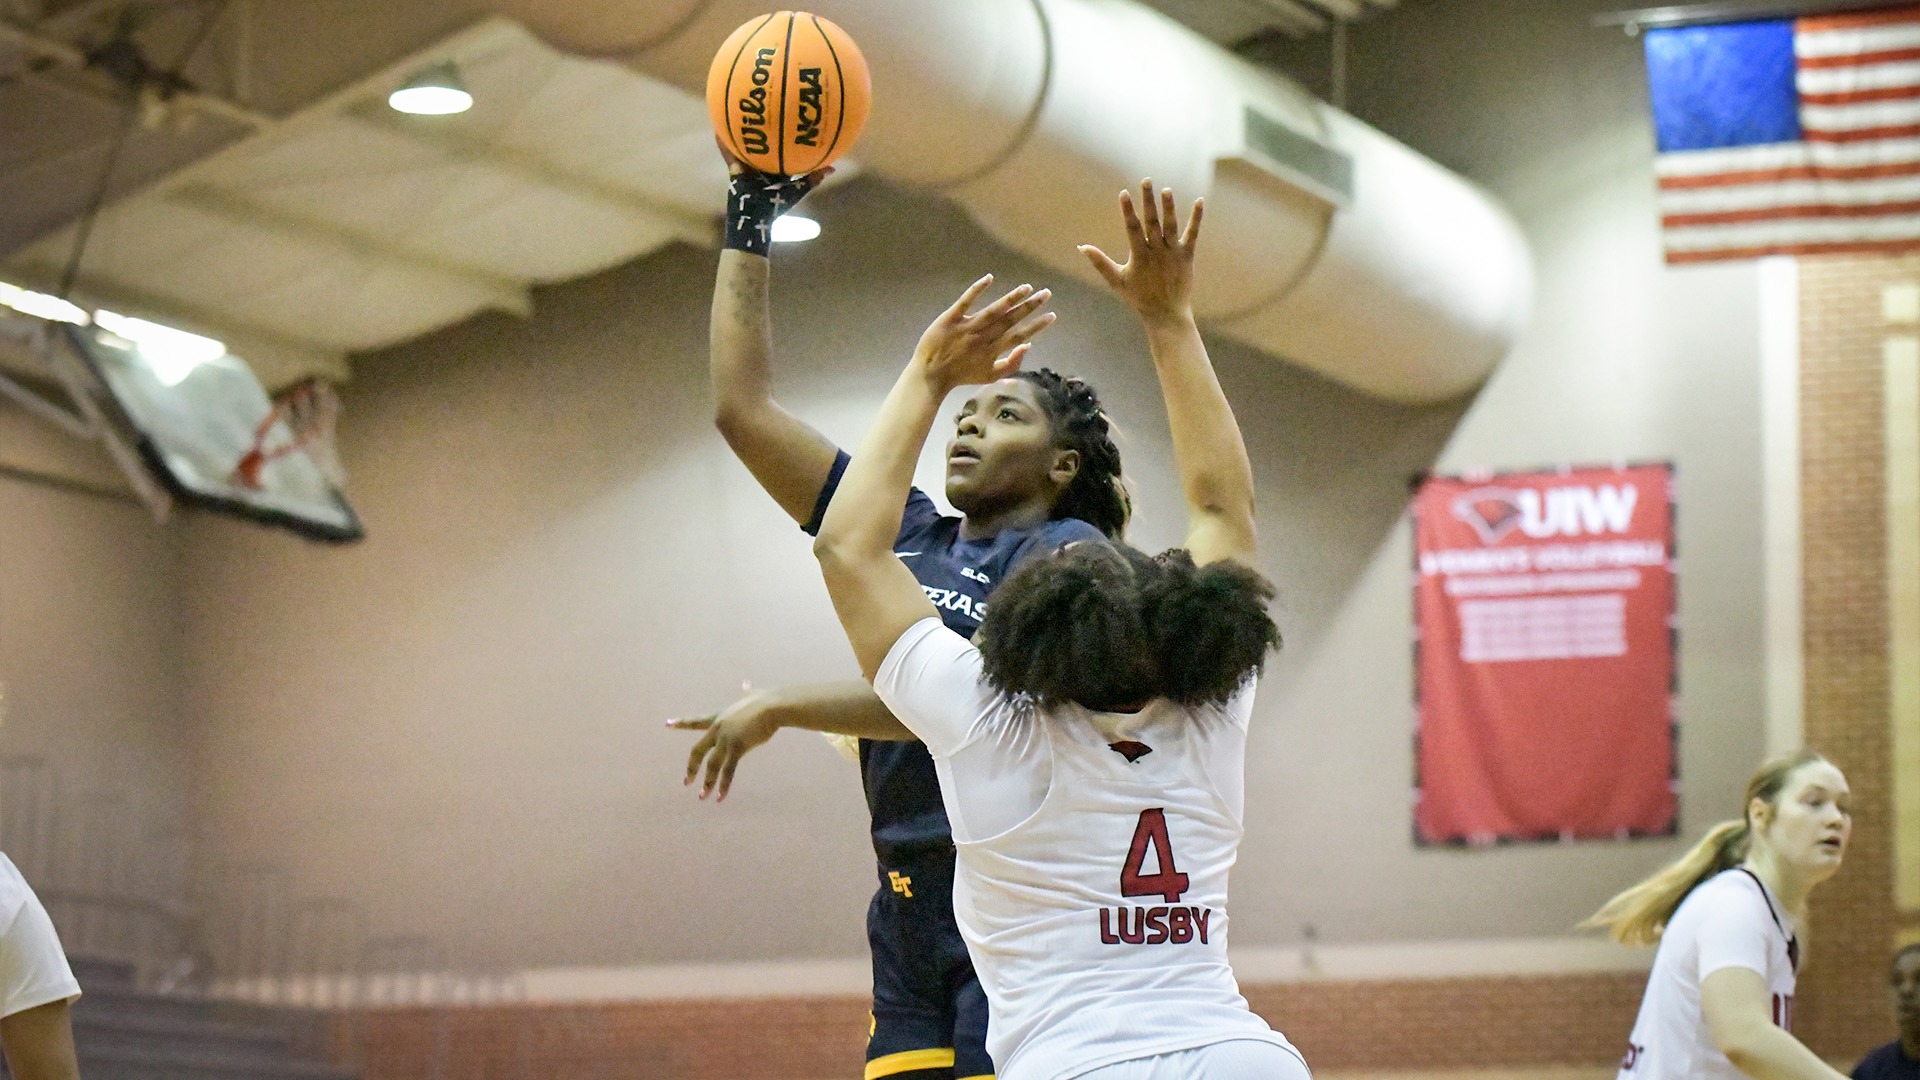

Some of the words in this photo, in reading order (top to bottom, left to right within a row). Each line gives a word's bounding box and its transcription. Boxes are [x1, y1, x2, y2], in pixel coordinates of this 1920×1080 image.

[739, 47, 777, 155] Wilson
[795, 67, 822, 147] NCAA
[1518, 484, 1638, 537] UIW
[1120, 807, 1190, 903] 4
[1099, 906, 1211, 945] LUSBY
